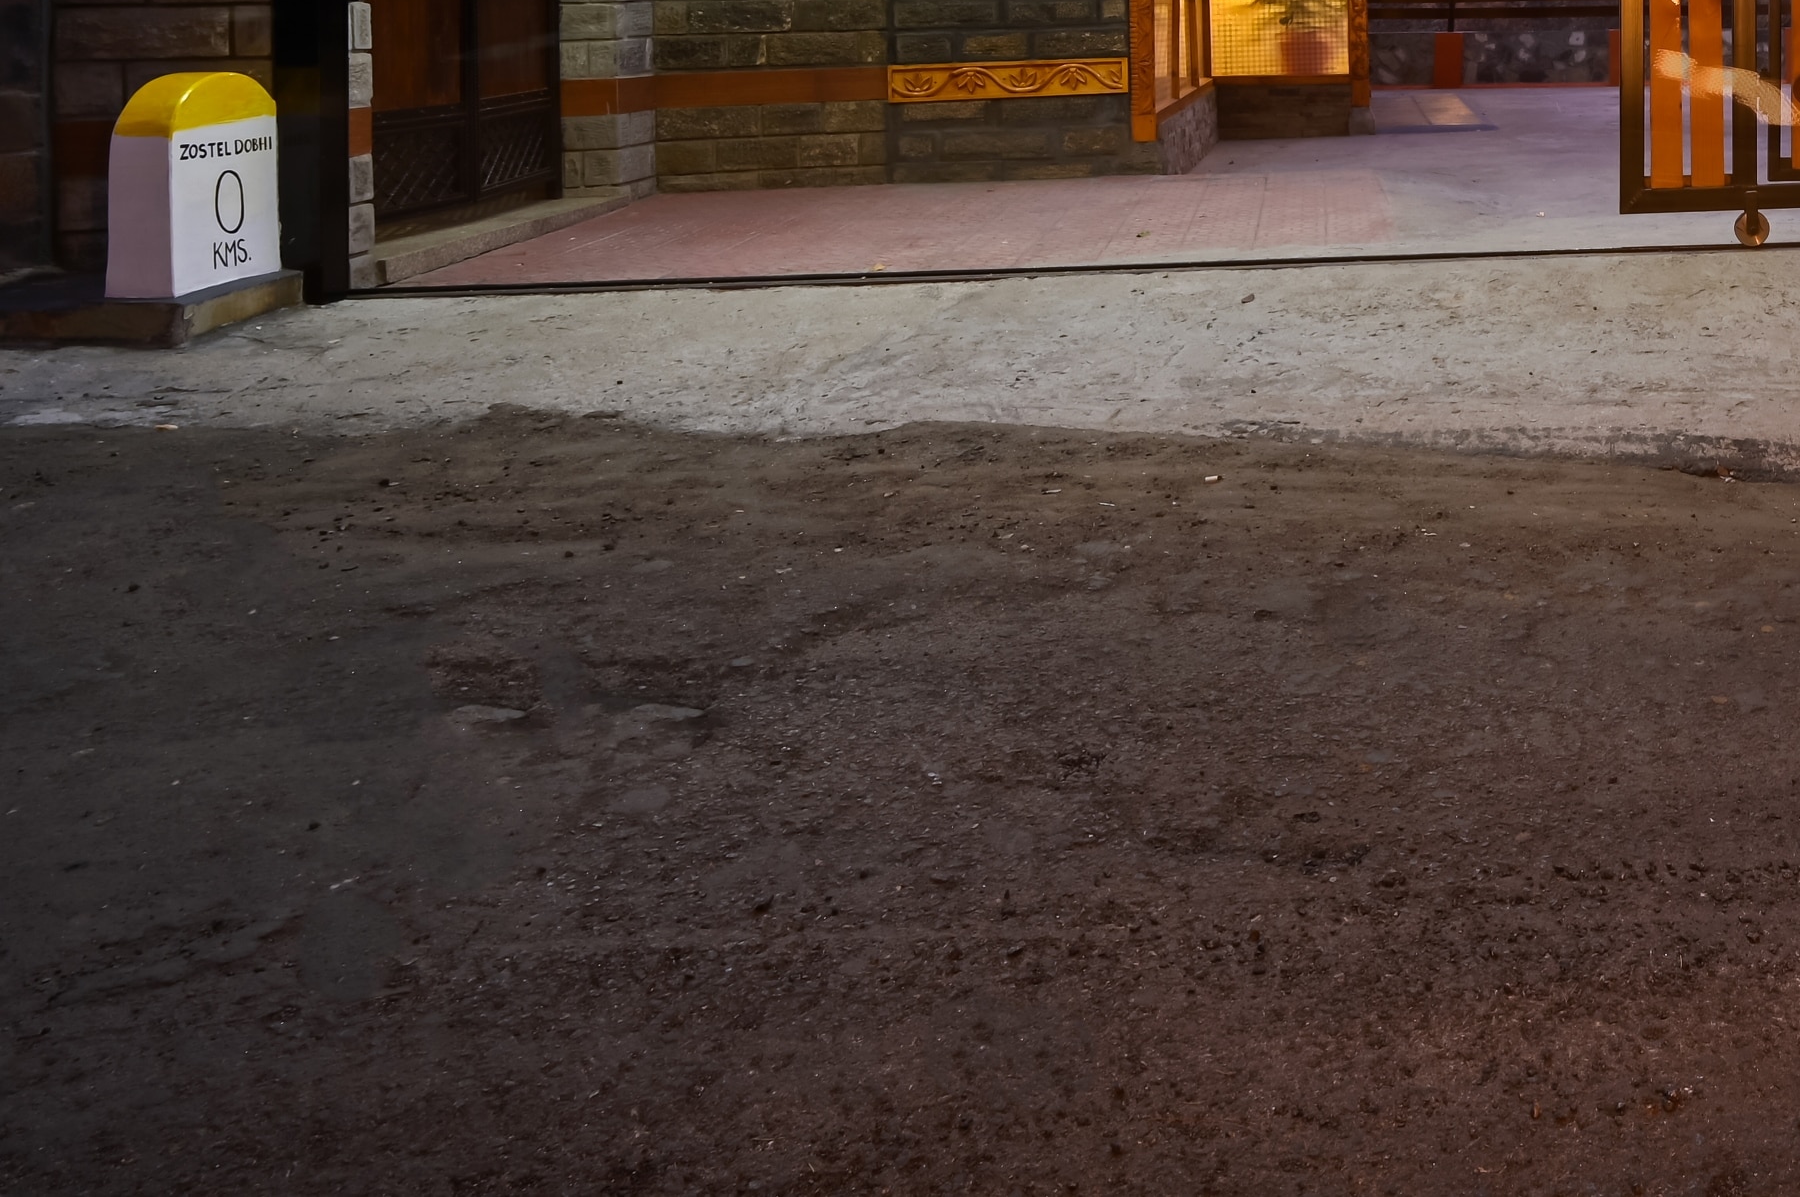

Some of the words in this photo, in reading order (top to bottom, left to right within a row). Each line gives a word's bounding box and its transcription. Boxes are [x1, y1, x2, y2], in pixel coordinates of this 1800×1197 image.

[179, 141, 231, 161] ZOSTEL
[234, 136, 273, 155] DOBHI
[215, 169, 245, 234] 0
[213, 238, 252, 270] KMS.
